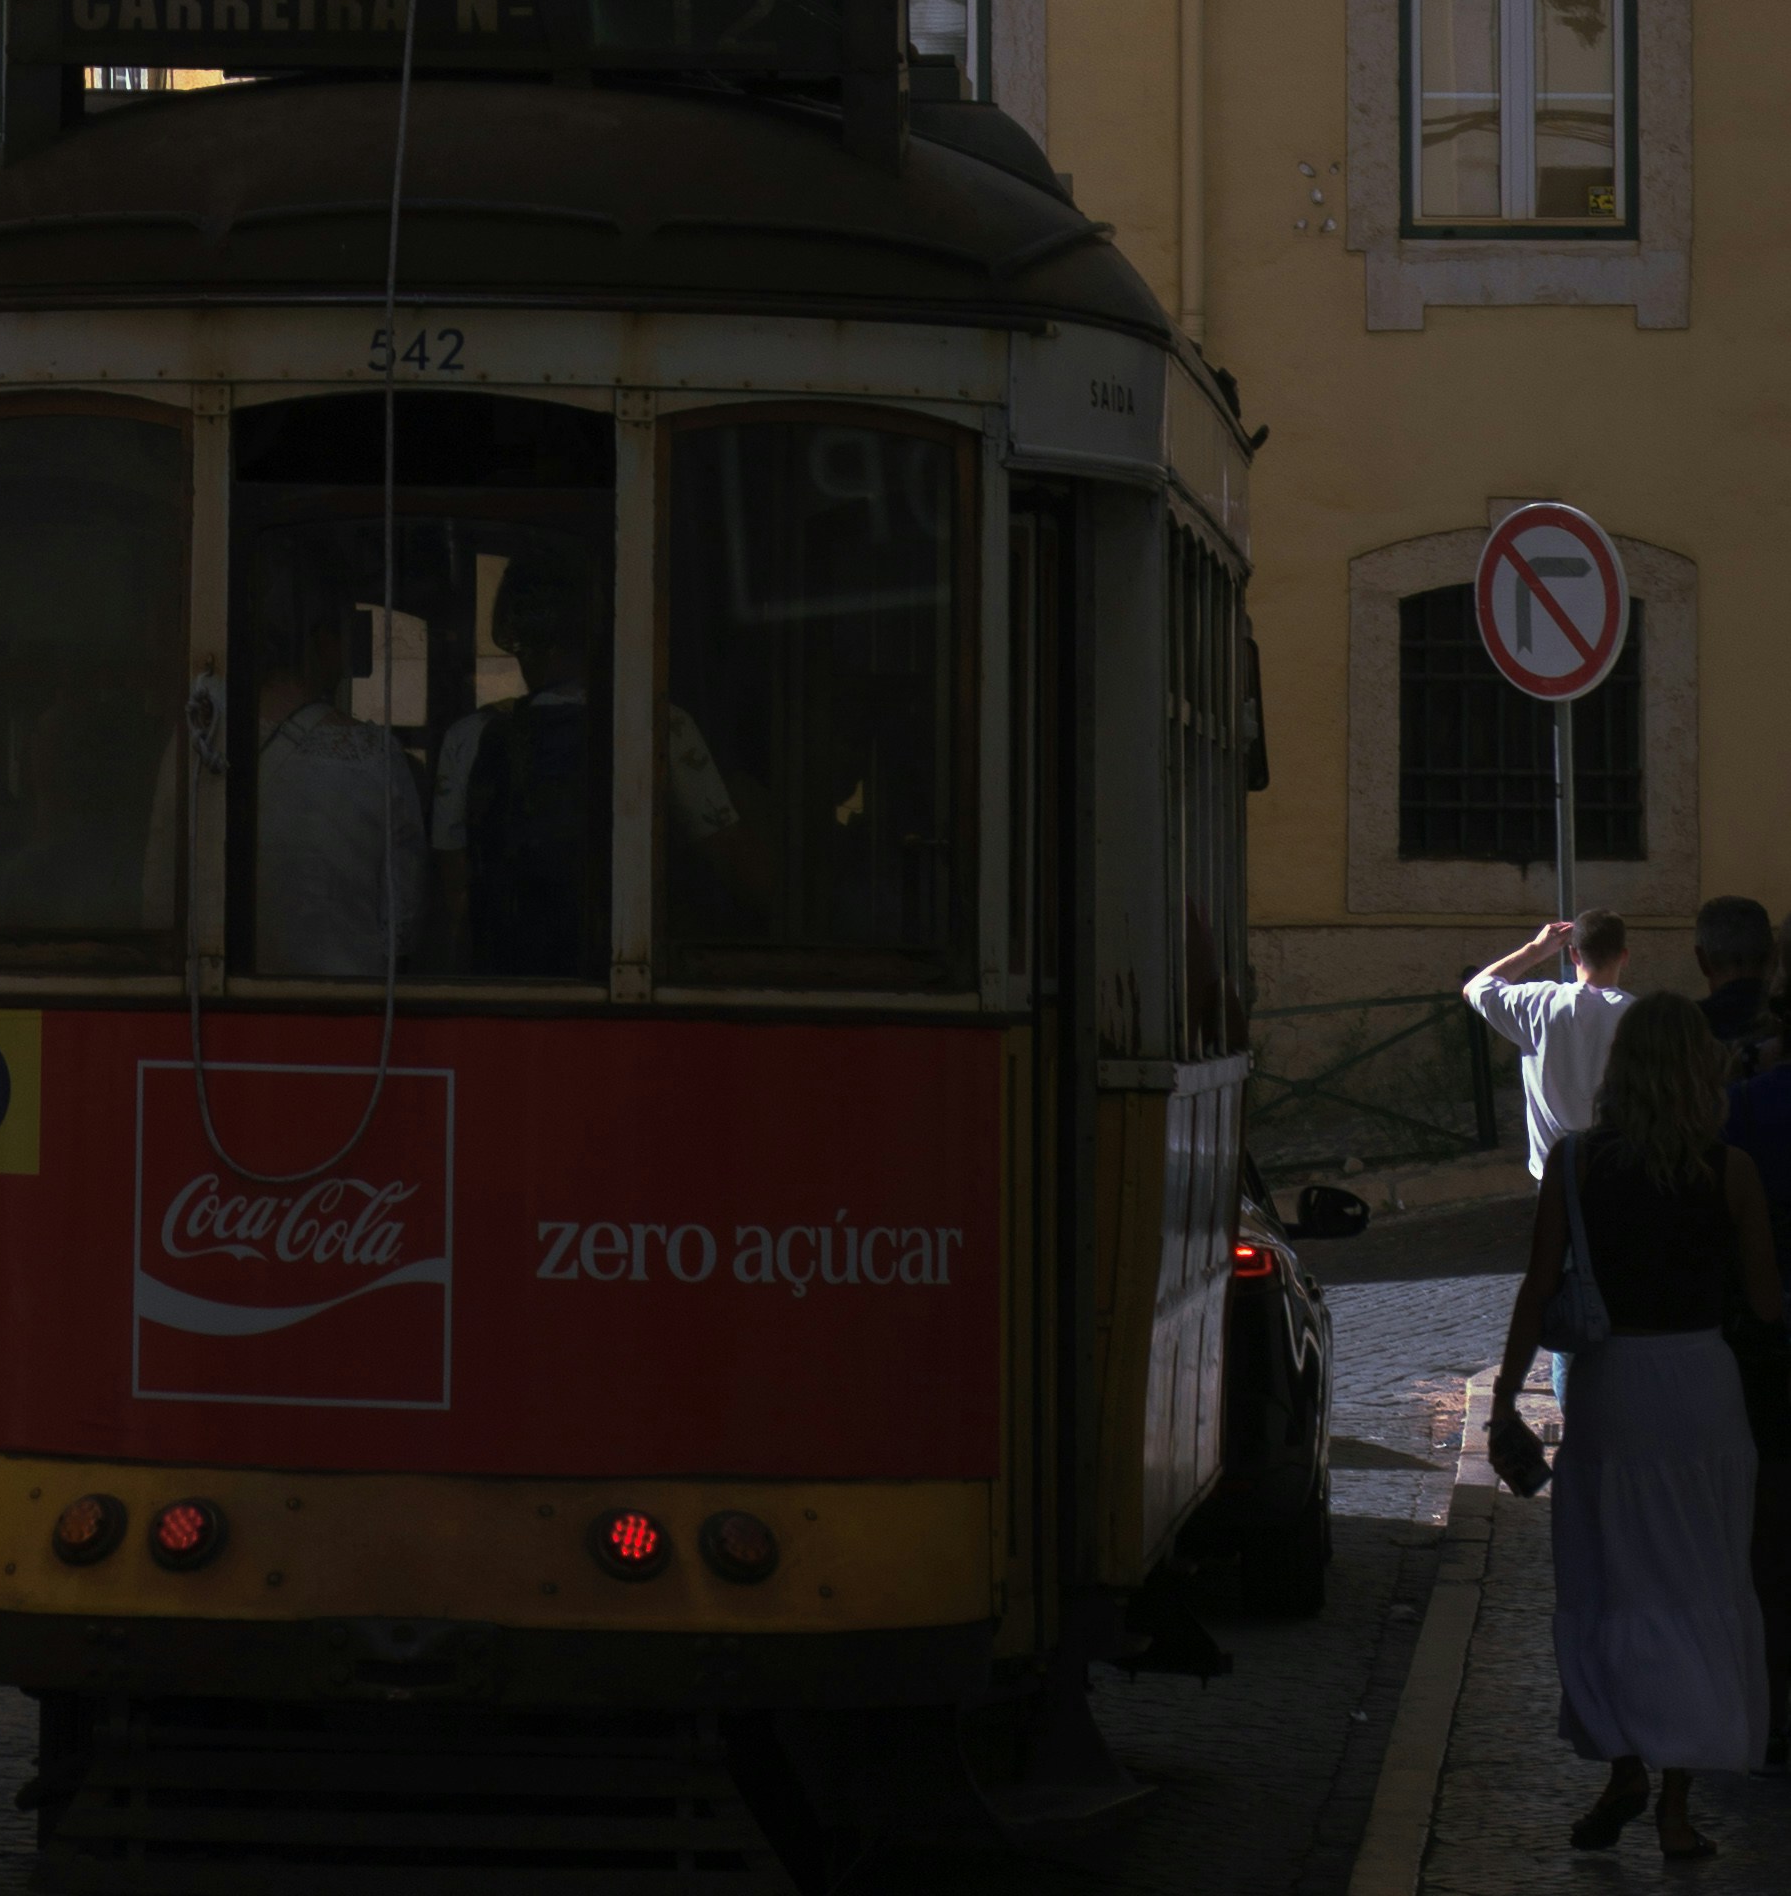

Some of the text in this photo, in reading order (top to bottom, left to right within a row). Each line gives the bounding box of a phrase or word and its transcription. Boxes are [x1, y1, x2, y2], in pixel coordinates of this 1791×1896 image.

[367, 327, 465, 372] 542
[1090, 374, 1136, 417] SAÍDA
[160, 1172, 422, 1266] Coca-Cola
[535, 1207, 964, 1299] zero açúcar
